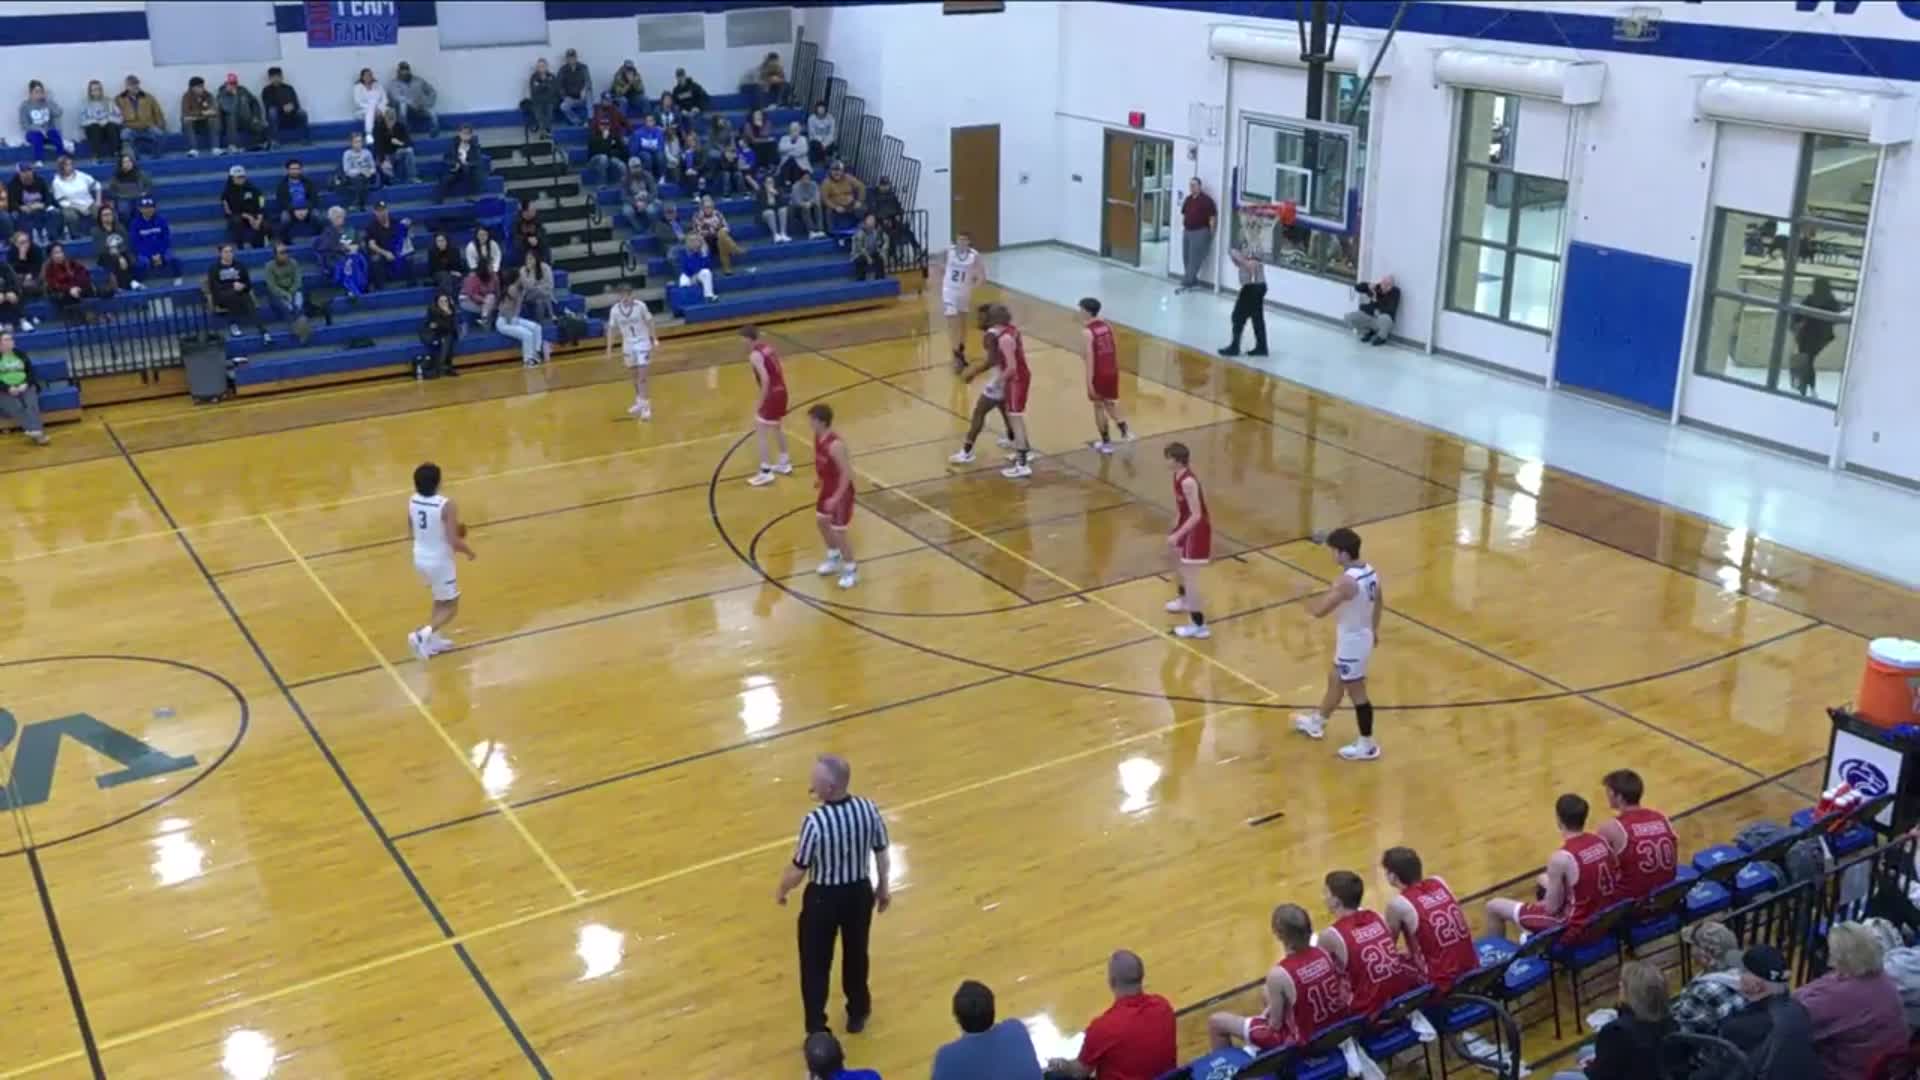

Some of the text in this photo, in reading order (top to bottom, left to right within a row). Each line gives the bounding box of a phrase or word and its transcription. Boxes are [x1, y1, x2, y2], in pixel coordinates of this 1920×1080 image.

[334, 23, 394, 41] FAMILY
[951, 269, 966, 283] 21
[417, 510, 428, 529] 3
[1635, 836, 1674, 873] 30
[1429, 903, 1468, 947] 20
[1361, 937, 1402, 983] 25
[1307, 974, 1342, 1023] 15
